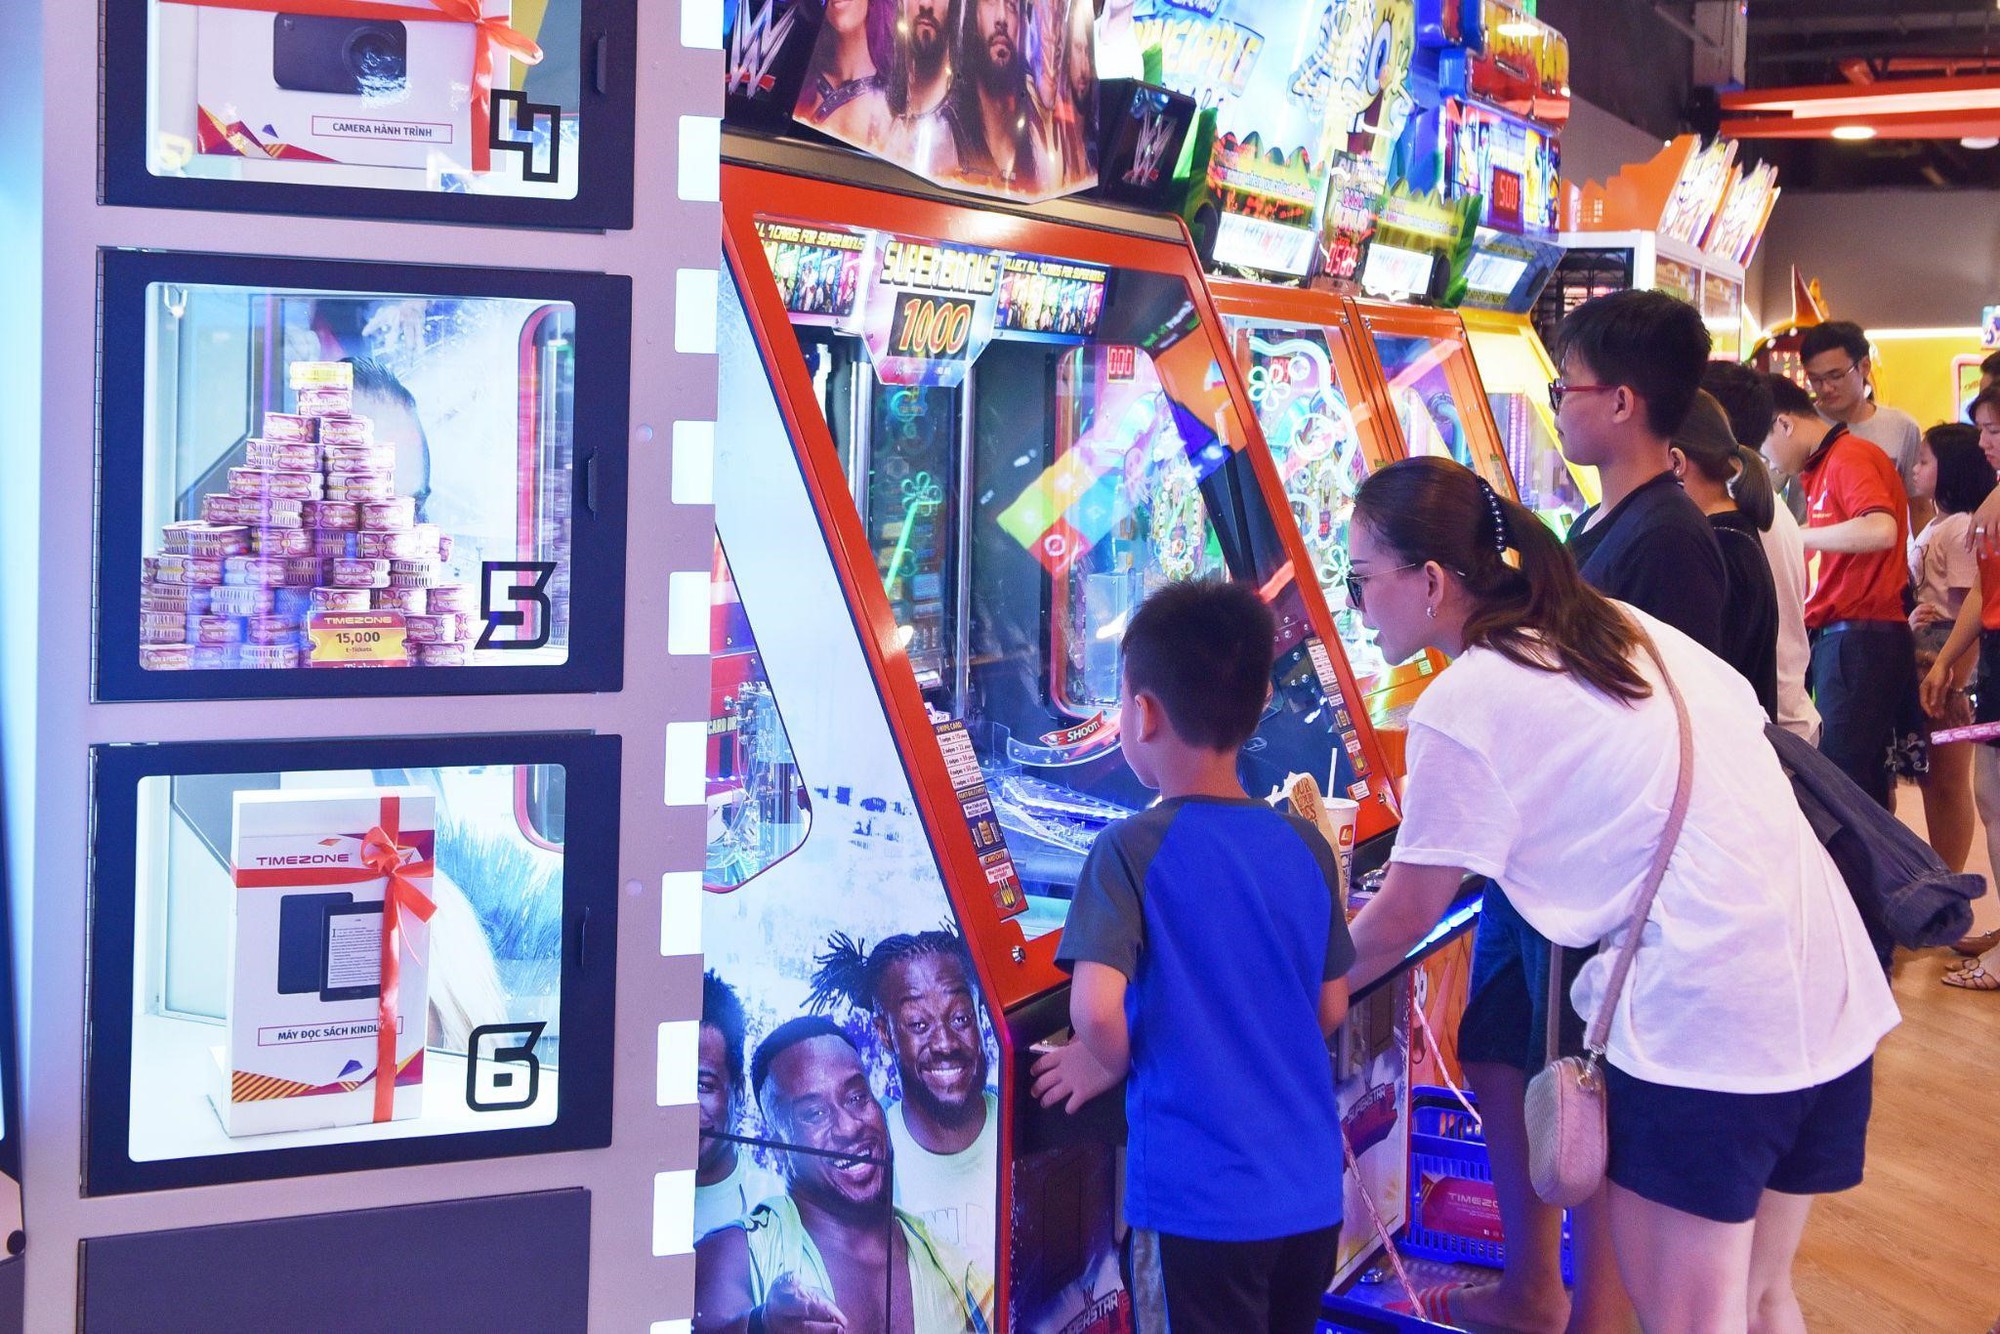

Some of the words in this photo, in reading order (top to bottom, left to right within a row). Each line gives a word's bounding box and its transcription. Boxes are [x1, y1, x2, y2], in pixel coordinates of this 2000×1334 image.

[332, 122, 372, 133] CAMERA
[374, 125, 401, 135] HÀNH
[403, 126, 433, 137] TRÌNH
[490, 89, 561, 183] 4
[1499, 174, 1519, 210] 500
[898, 298, 972, 355] 1000
[1109, 348, 1134, 375] 000
[475, 561, 557, 651] 5
[324, 616, 392, 625] TIMEZONE
[336, 631, 380, 645] 15,000
[256, 853, 349, 866] TIMEZONE
[278, 1029, 299, 1040] MÁY
[301, 1029, 320, 1040] ĐỌC
[323, 1025, 348, 1037] SÁCH
[350, 1024, 379, 1035] KINDL
[466, 1021, 548, 1113] 6
[1448, 1192, 1499, 1209] TIMEZO
[1062, 1291, 1119, 1334] PERSTAR
